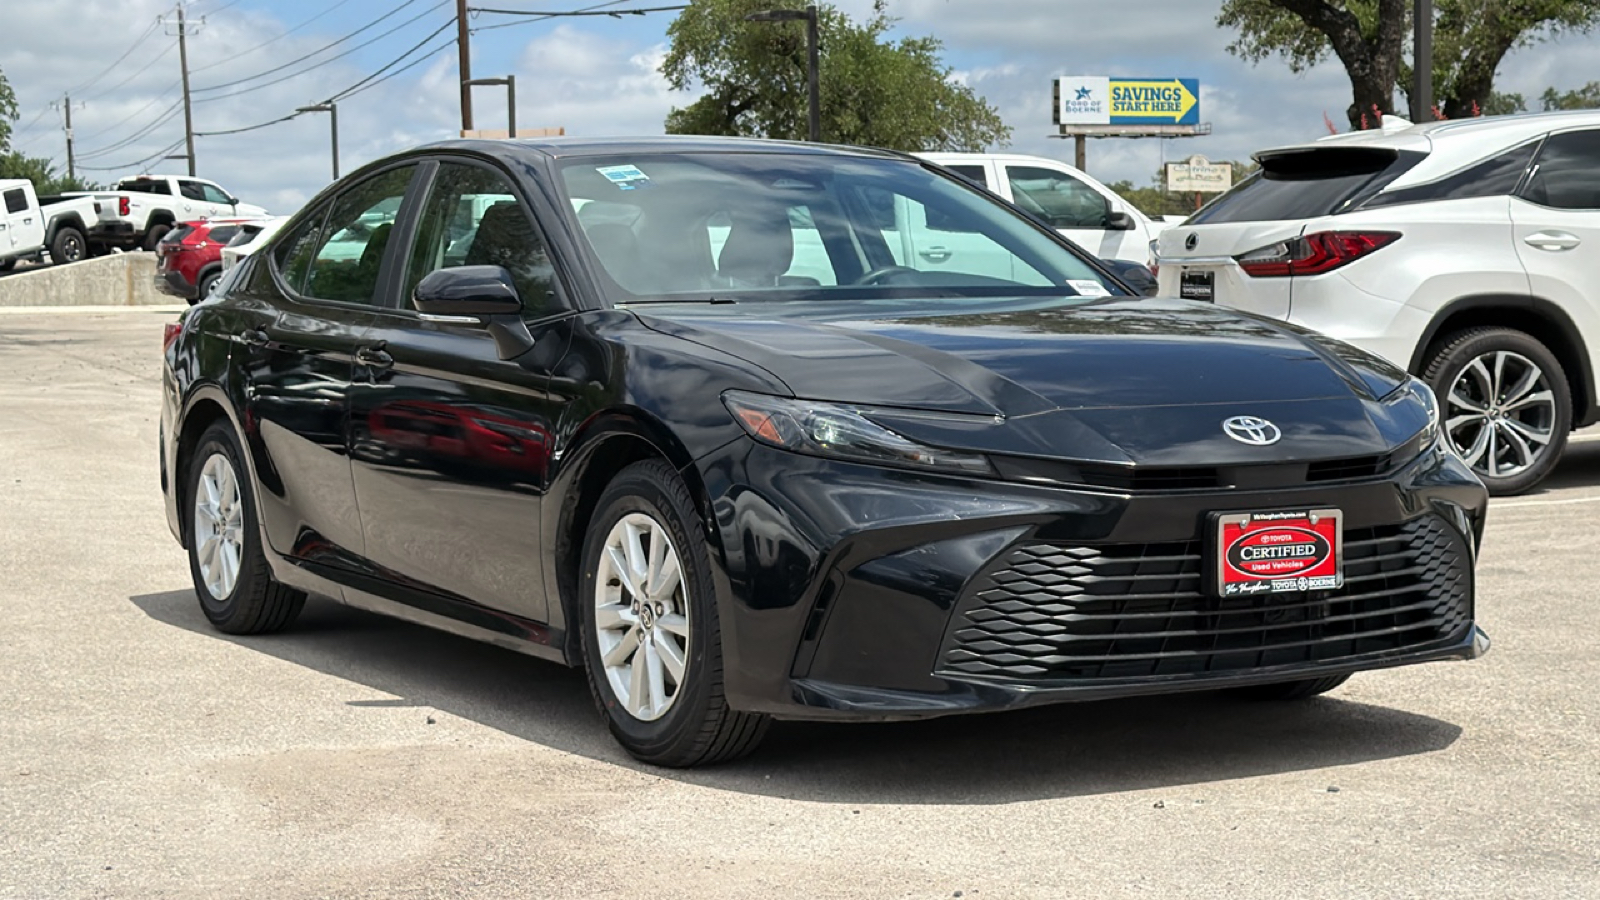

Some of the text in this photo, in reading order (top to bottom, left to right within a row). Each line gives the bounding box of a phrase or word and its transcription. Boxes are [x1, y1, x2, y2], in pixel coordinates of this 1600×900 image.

[1112, 86, 1182, 101] SAVINGS
[1113, 101, 1182, 112] START HERE
[1269, 534, 1293, 542] TOYOTA
[1240, 544, 1317, 561] CERTIFIED
[1251, 560, 1305, 571] Used Vehicles
[1272, 578, 1336, 590] TOYOTA BOERNE
